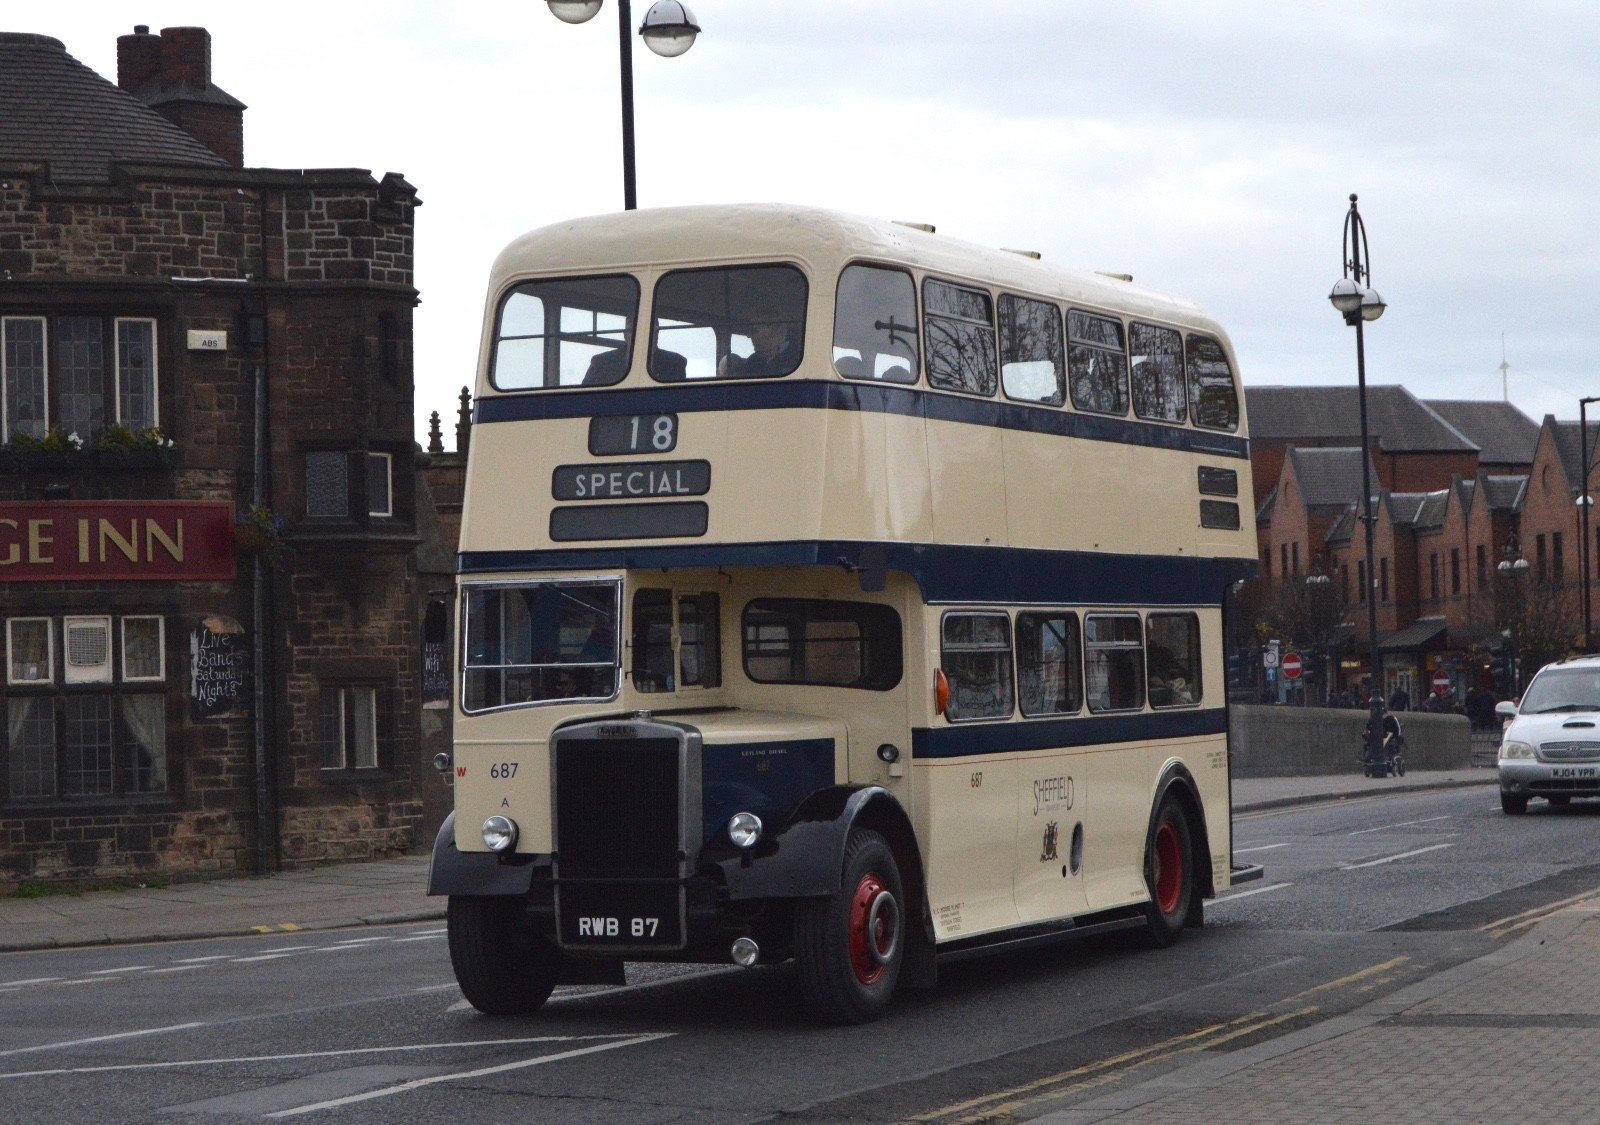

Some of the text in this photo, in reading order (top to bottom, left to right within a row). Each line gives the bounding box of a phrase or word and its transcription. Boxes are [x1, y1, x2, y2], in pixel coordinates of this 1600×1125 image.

[201, 339, 218, 347] ABS
[630, 415, 673, 450] 18
[575, 469, 690, 497] SPECIAL
[77, 518, 184, 563] INN
[200, 628, 231, 649] Live
[196, 666, 243, 686] Saturday
[198, 681, 237, 707] Nights
[456, 766, 467, 777] W
[490, 762, 519, 779] 687
[970, 771, 983, 788] 687
[1552, 768, 1596, 778] MJ04 VPR
[501, 797, 510, 808] A
[1033, 775, 1074, 817] SHEFFIELD
[578, 917, 659, 937] RWB 87
